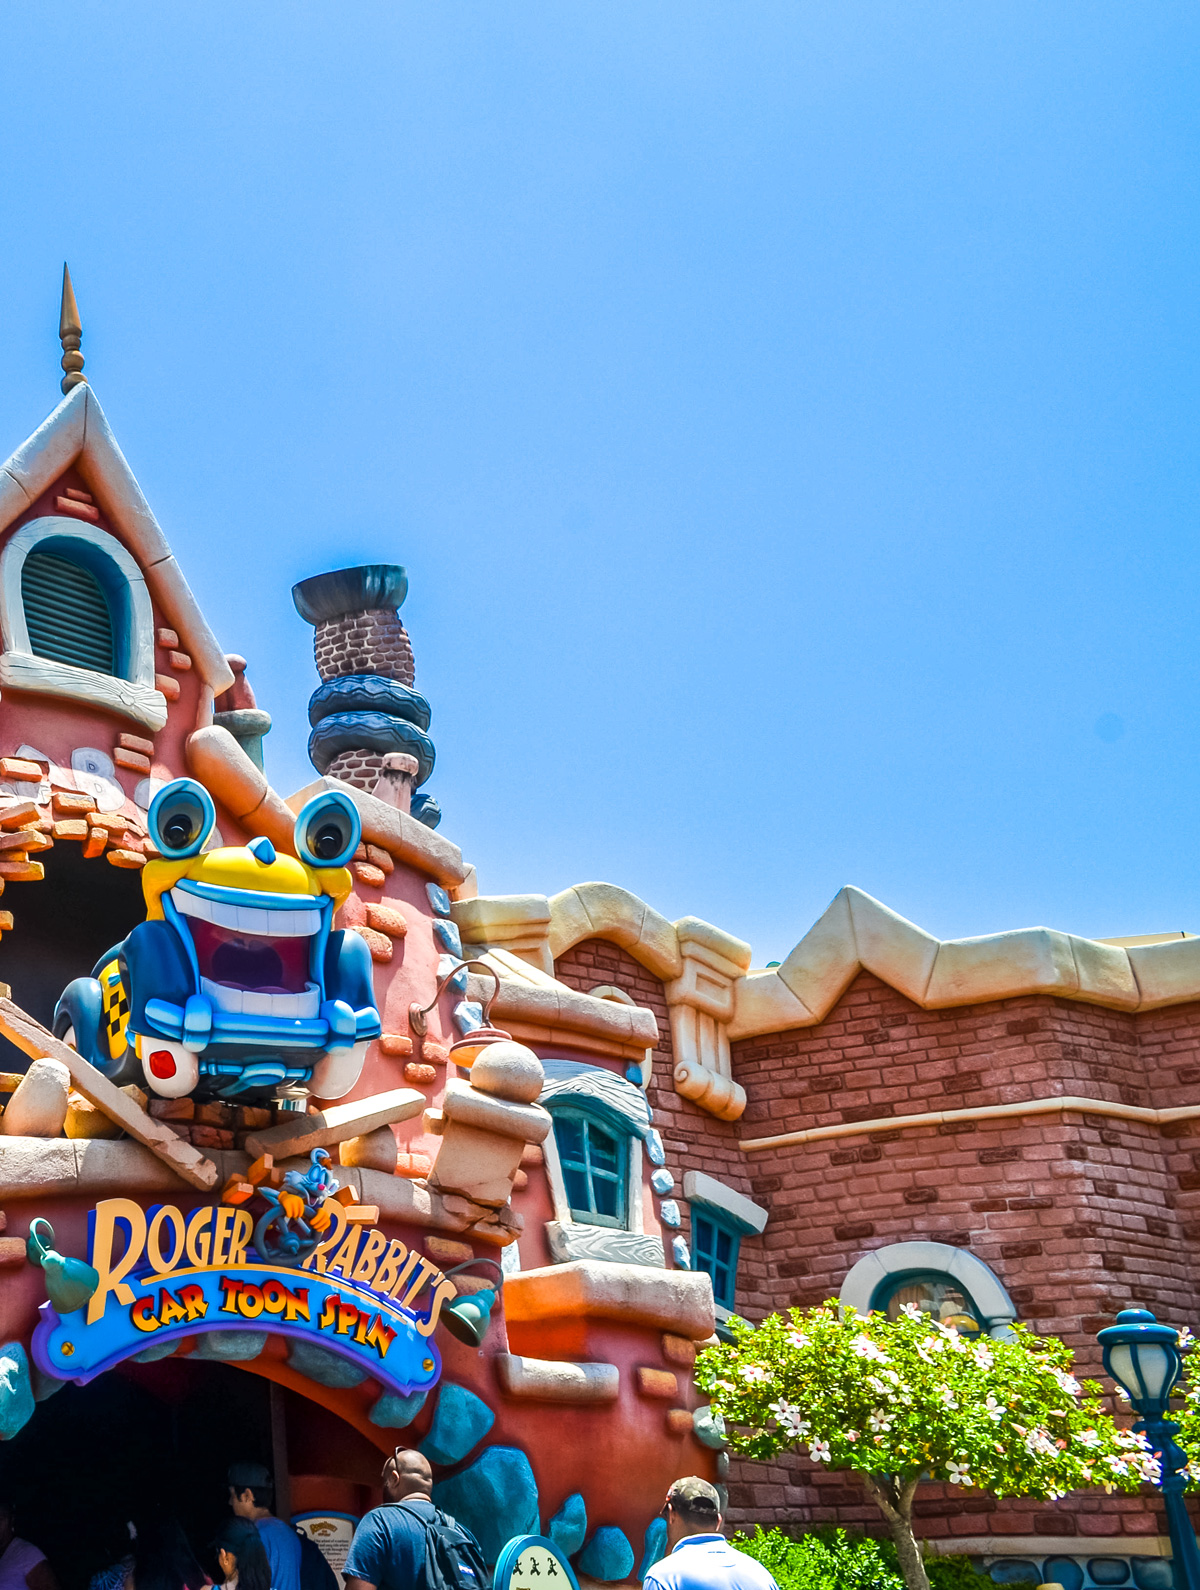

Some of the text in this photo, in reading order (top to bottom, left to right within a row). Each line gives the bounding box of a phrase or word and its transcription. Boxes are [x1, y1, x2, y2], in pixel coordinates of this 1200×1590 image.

[87, 1197, 458, 1337] ROGER RABBIT'S
[130, 1276, 398, 1358] CAR TOON SPIN
